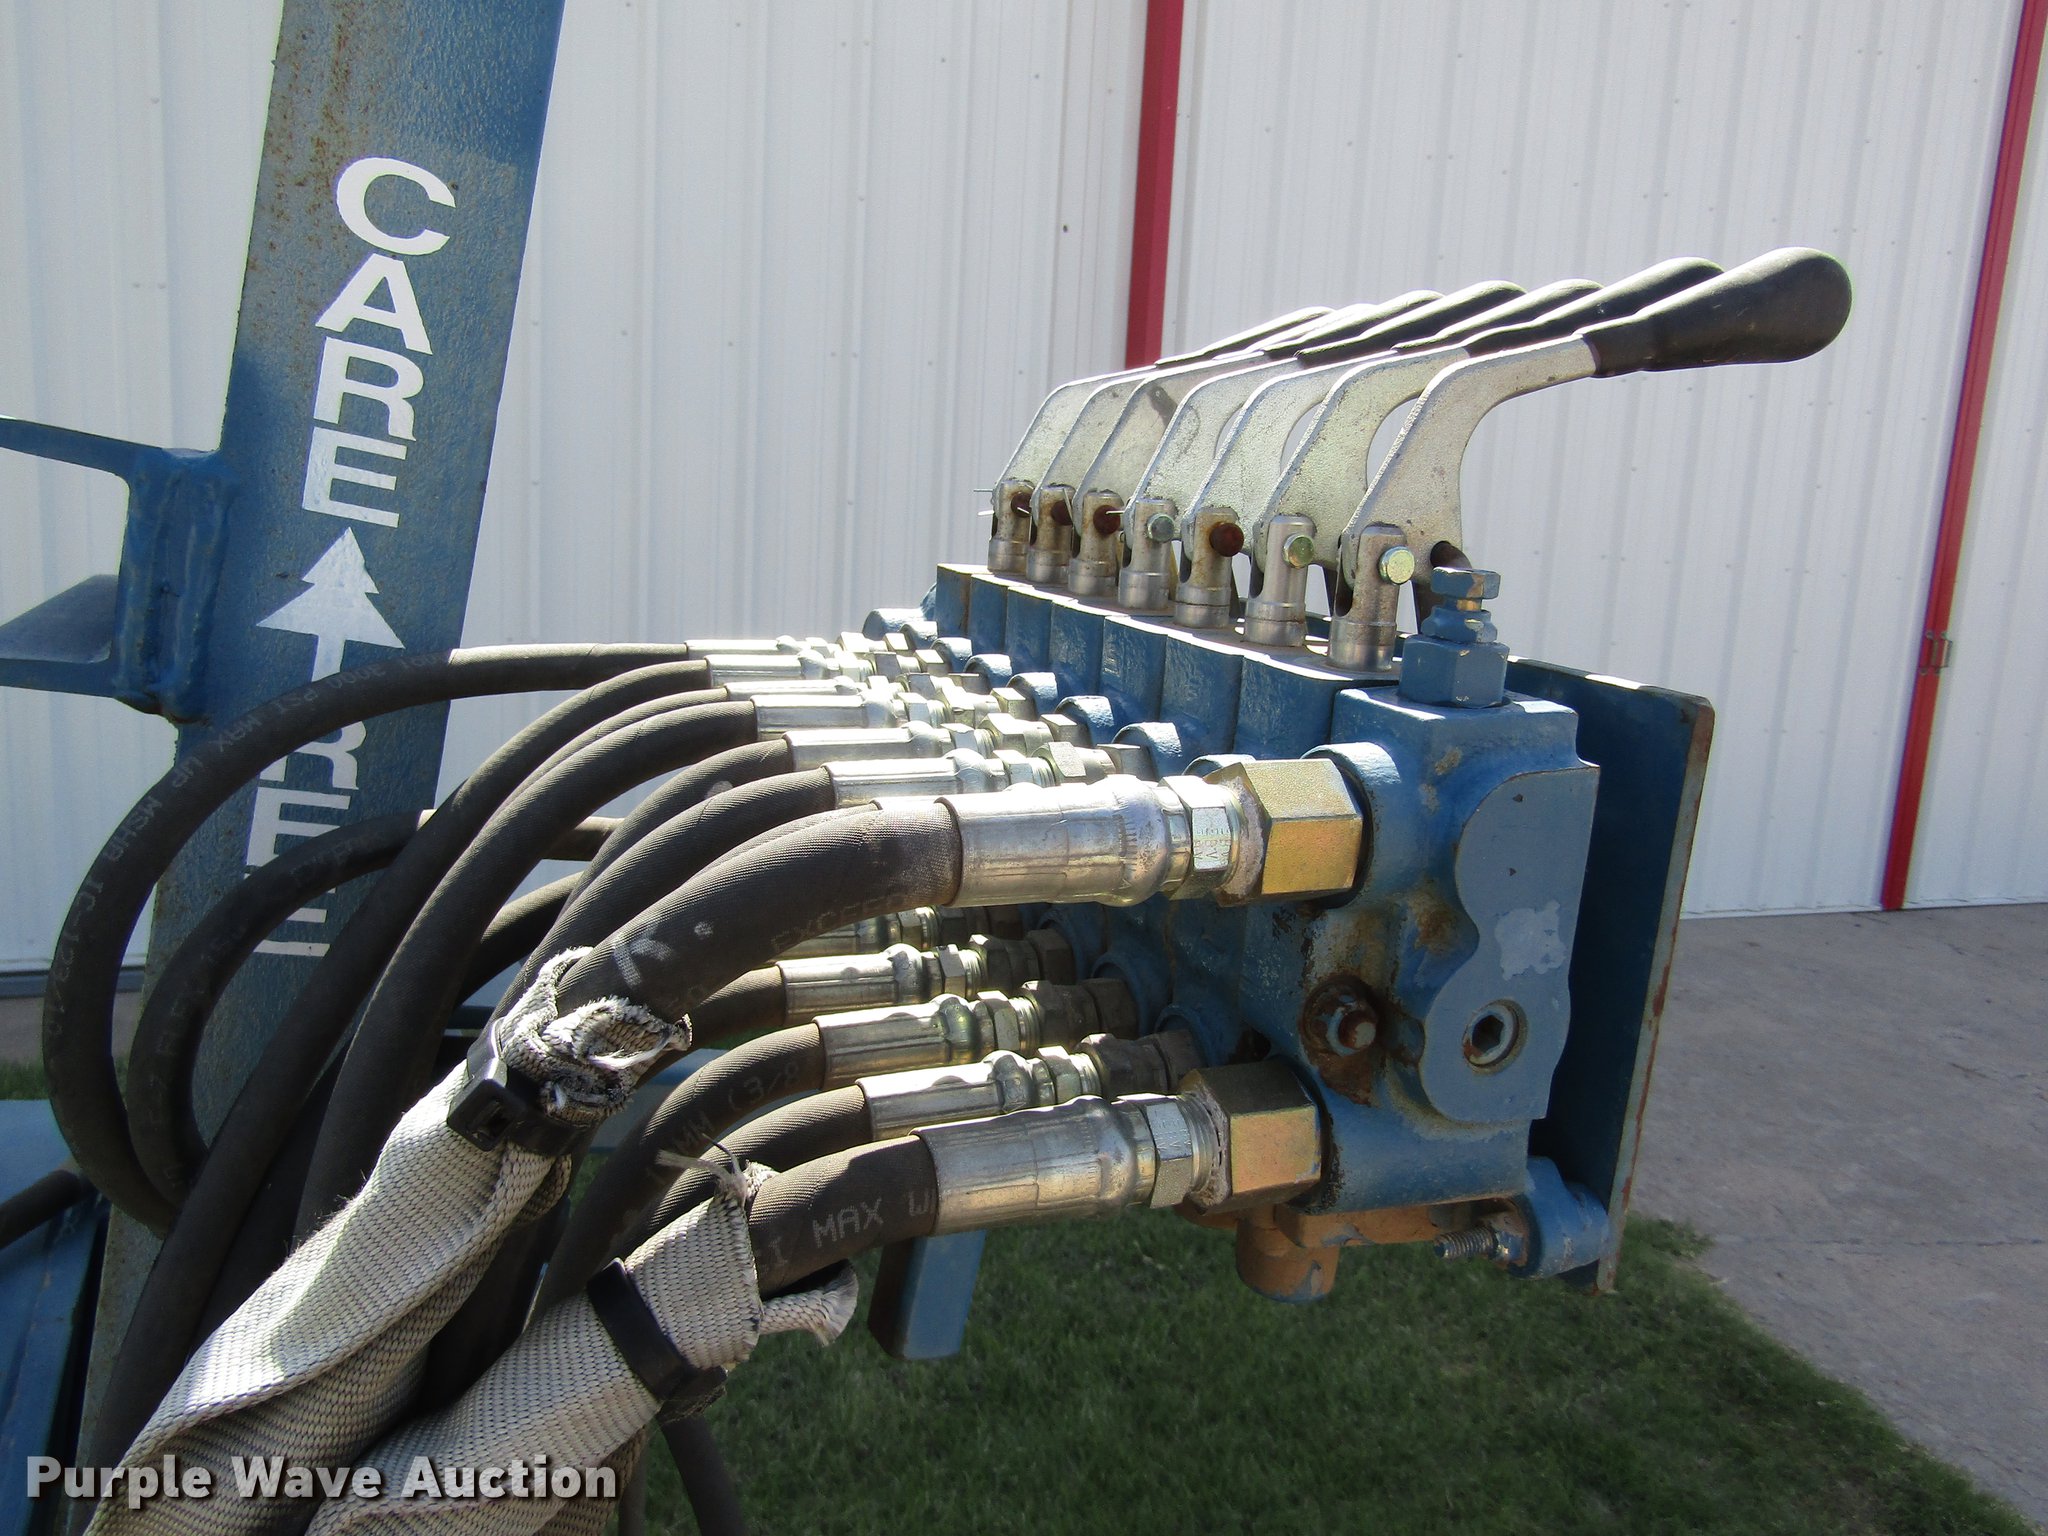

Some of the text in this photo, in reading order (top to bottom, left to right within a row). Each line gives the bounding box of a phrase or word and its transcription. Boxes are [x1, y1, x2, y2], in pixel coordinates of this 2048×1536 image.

[302, 156, 456, 528] CARE
[212, 713, 262, 753] MAX
[104, 796, 163, 863] MSHA
[812, 1197, 884, 1249] MAX
